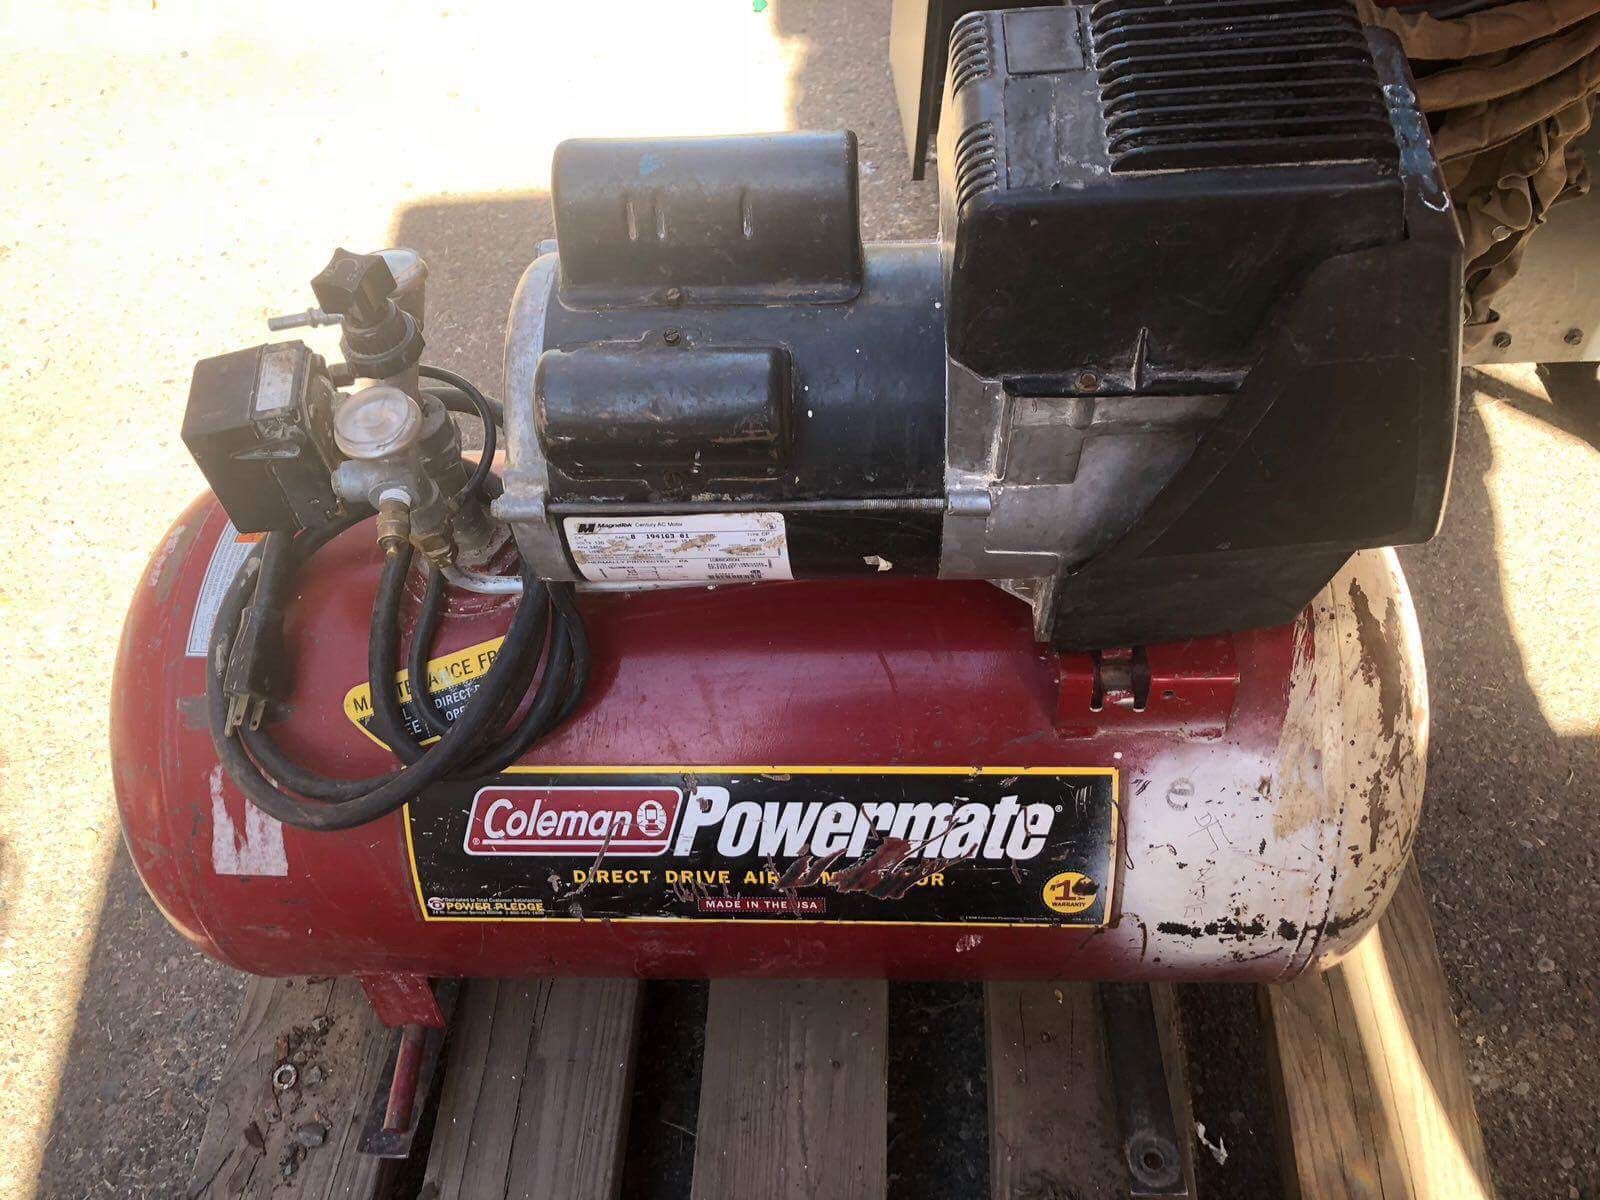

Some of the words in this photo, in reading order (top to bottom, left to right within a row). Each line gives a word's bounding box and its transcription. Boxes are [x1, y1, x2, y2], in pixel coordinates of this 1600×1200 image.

[483, 798, 633, 839] Coleman
[673, 786, 1056, 860] Powermate
[573, 870, 652, 884] DIRECT
[665, 870, 731, 884] DRIVE
[743, 870, 782, 884] AIR
[446, 902, 491, 911] POWER
[495, 902, 543, 912] PLEDGE
[705, 900, 741, 909] MADE
[747, 900, 758, 909] IN
[764, 900, 787, 909] THE
